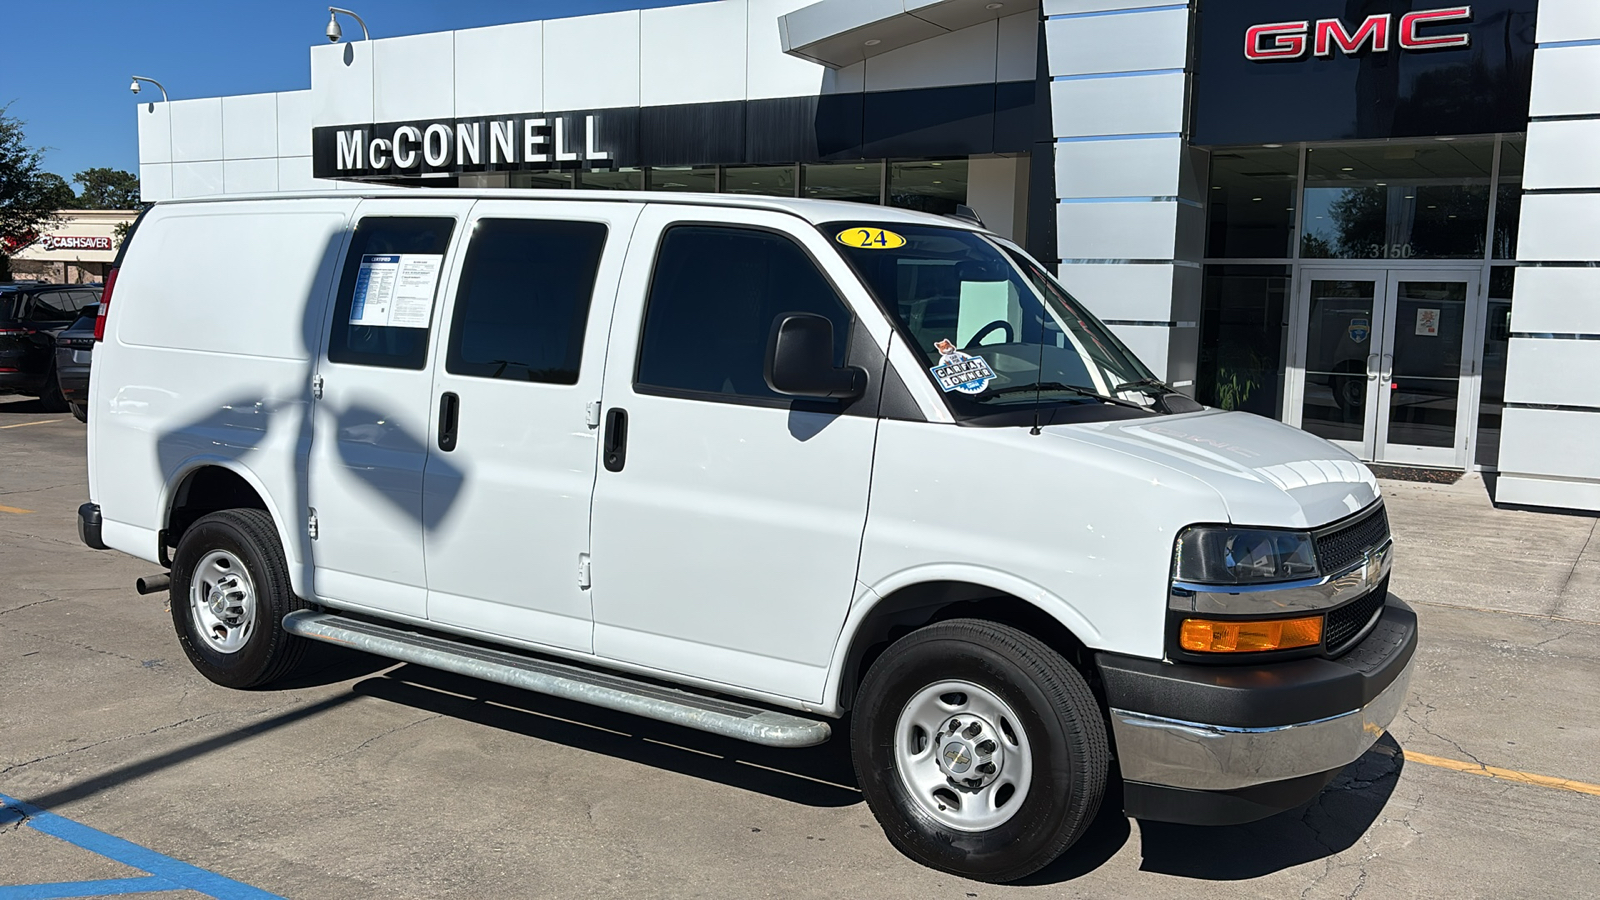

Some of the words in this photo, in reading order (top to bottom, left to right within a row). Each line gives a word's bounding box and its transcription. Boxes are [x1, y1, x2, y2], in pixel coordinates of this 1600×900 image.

[1244, 6, 1471, 60] GMC
[857, 229, 888, 247] 24
[1369, 243, 1412, 259] 3150
[937, 361, 985, 377] CARFAX
